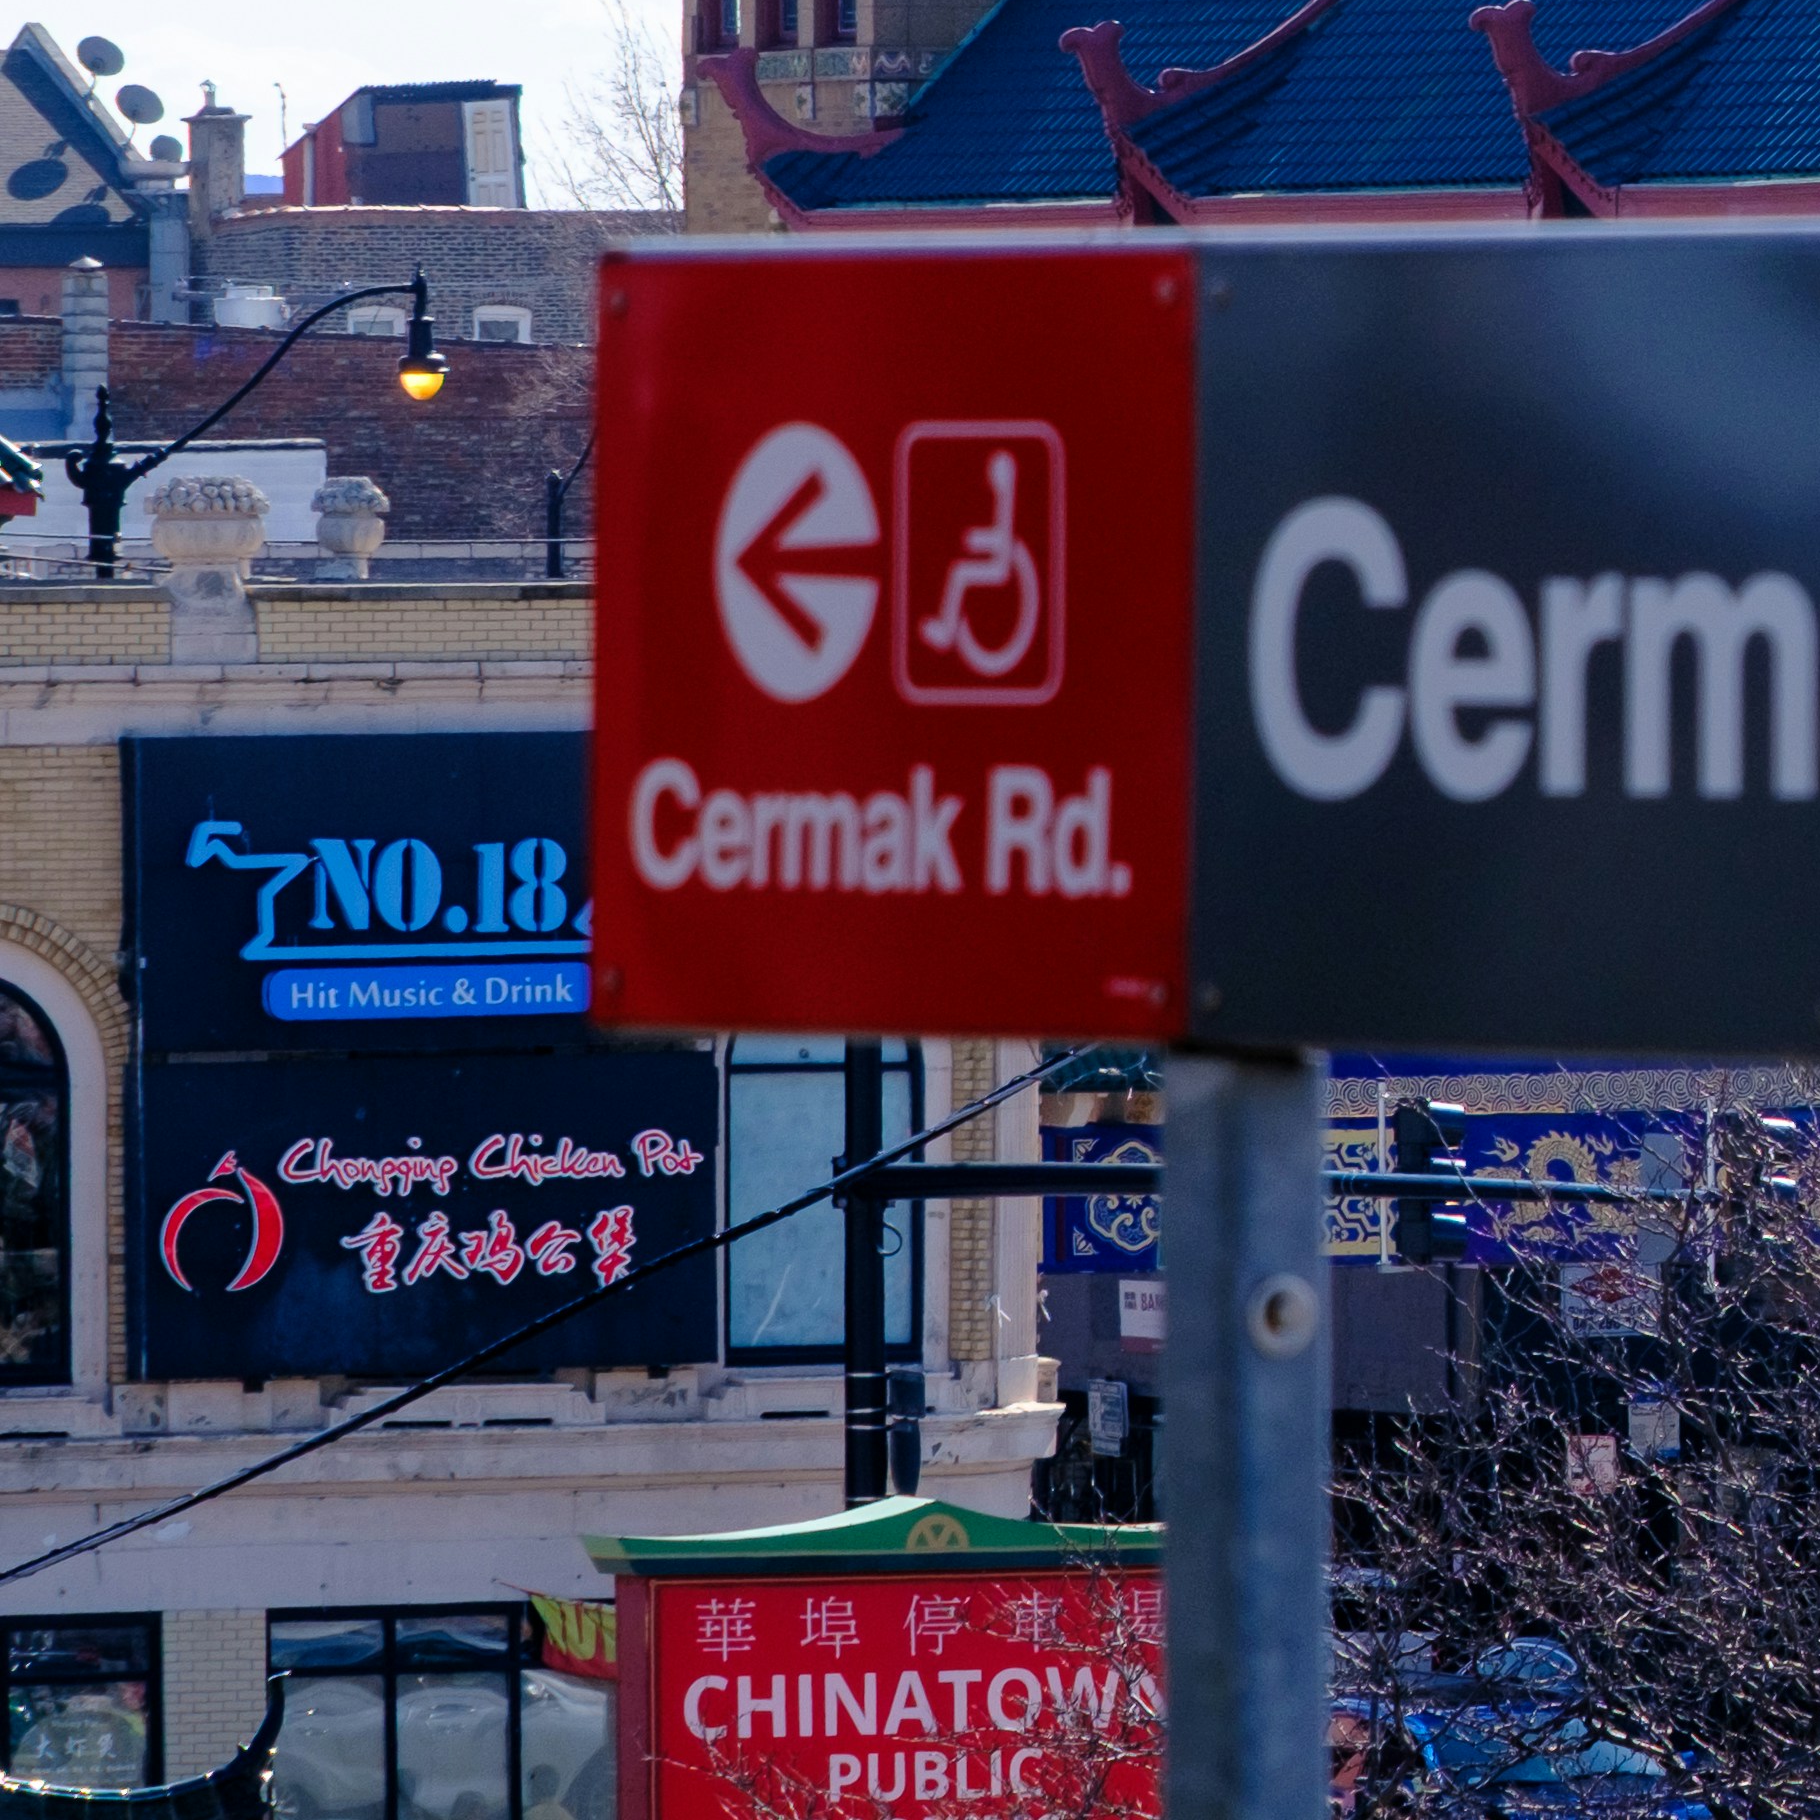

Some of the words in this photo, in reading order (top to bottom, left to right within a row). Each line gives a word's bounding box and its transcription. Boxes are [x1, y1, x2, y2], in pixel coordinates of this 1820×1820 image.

[629, 757, 964, 894] Cermak
[986, 764, 1132, 896] Rd.
[308, 837, 568, 933] NO.18
[290, 981, 340, 1009] Hit
[349, 978, 444, 1008] Music
[452, 978, 477, 1006] &
[485, 973, 574, 1005] Drink
[277, 1136, 459, 1196] Chongqing
[469, 1134, 625, 1186] Chicken
[631, 1129, 705, 1177] Pot
[341, 1205, 635, 1293] 重庆鸡公煲
[828, 1747, 1043, 1802] PUBLIC
